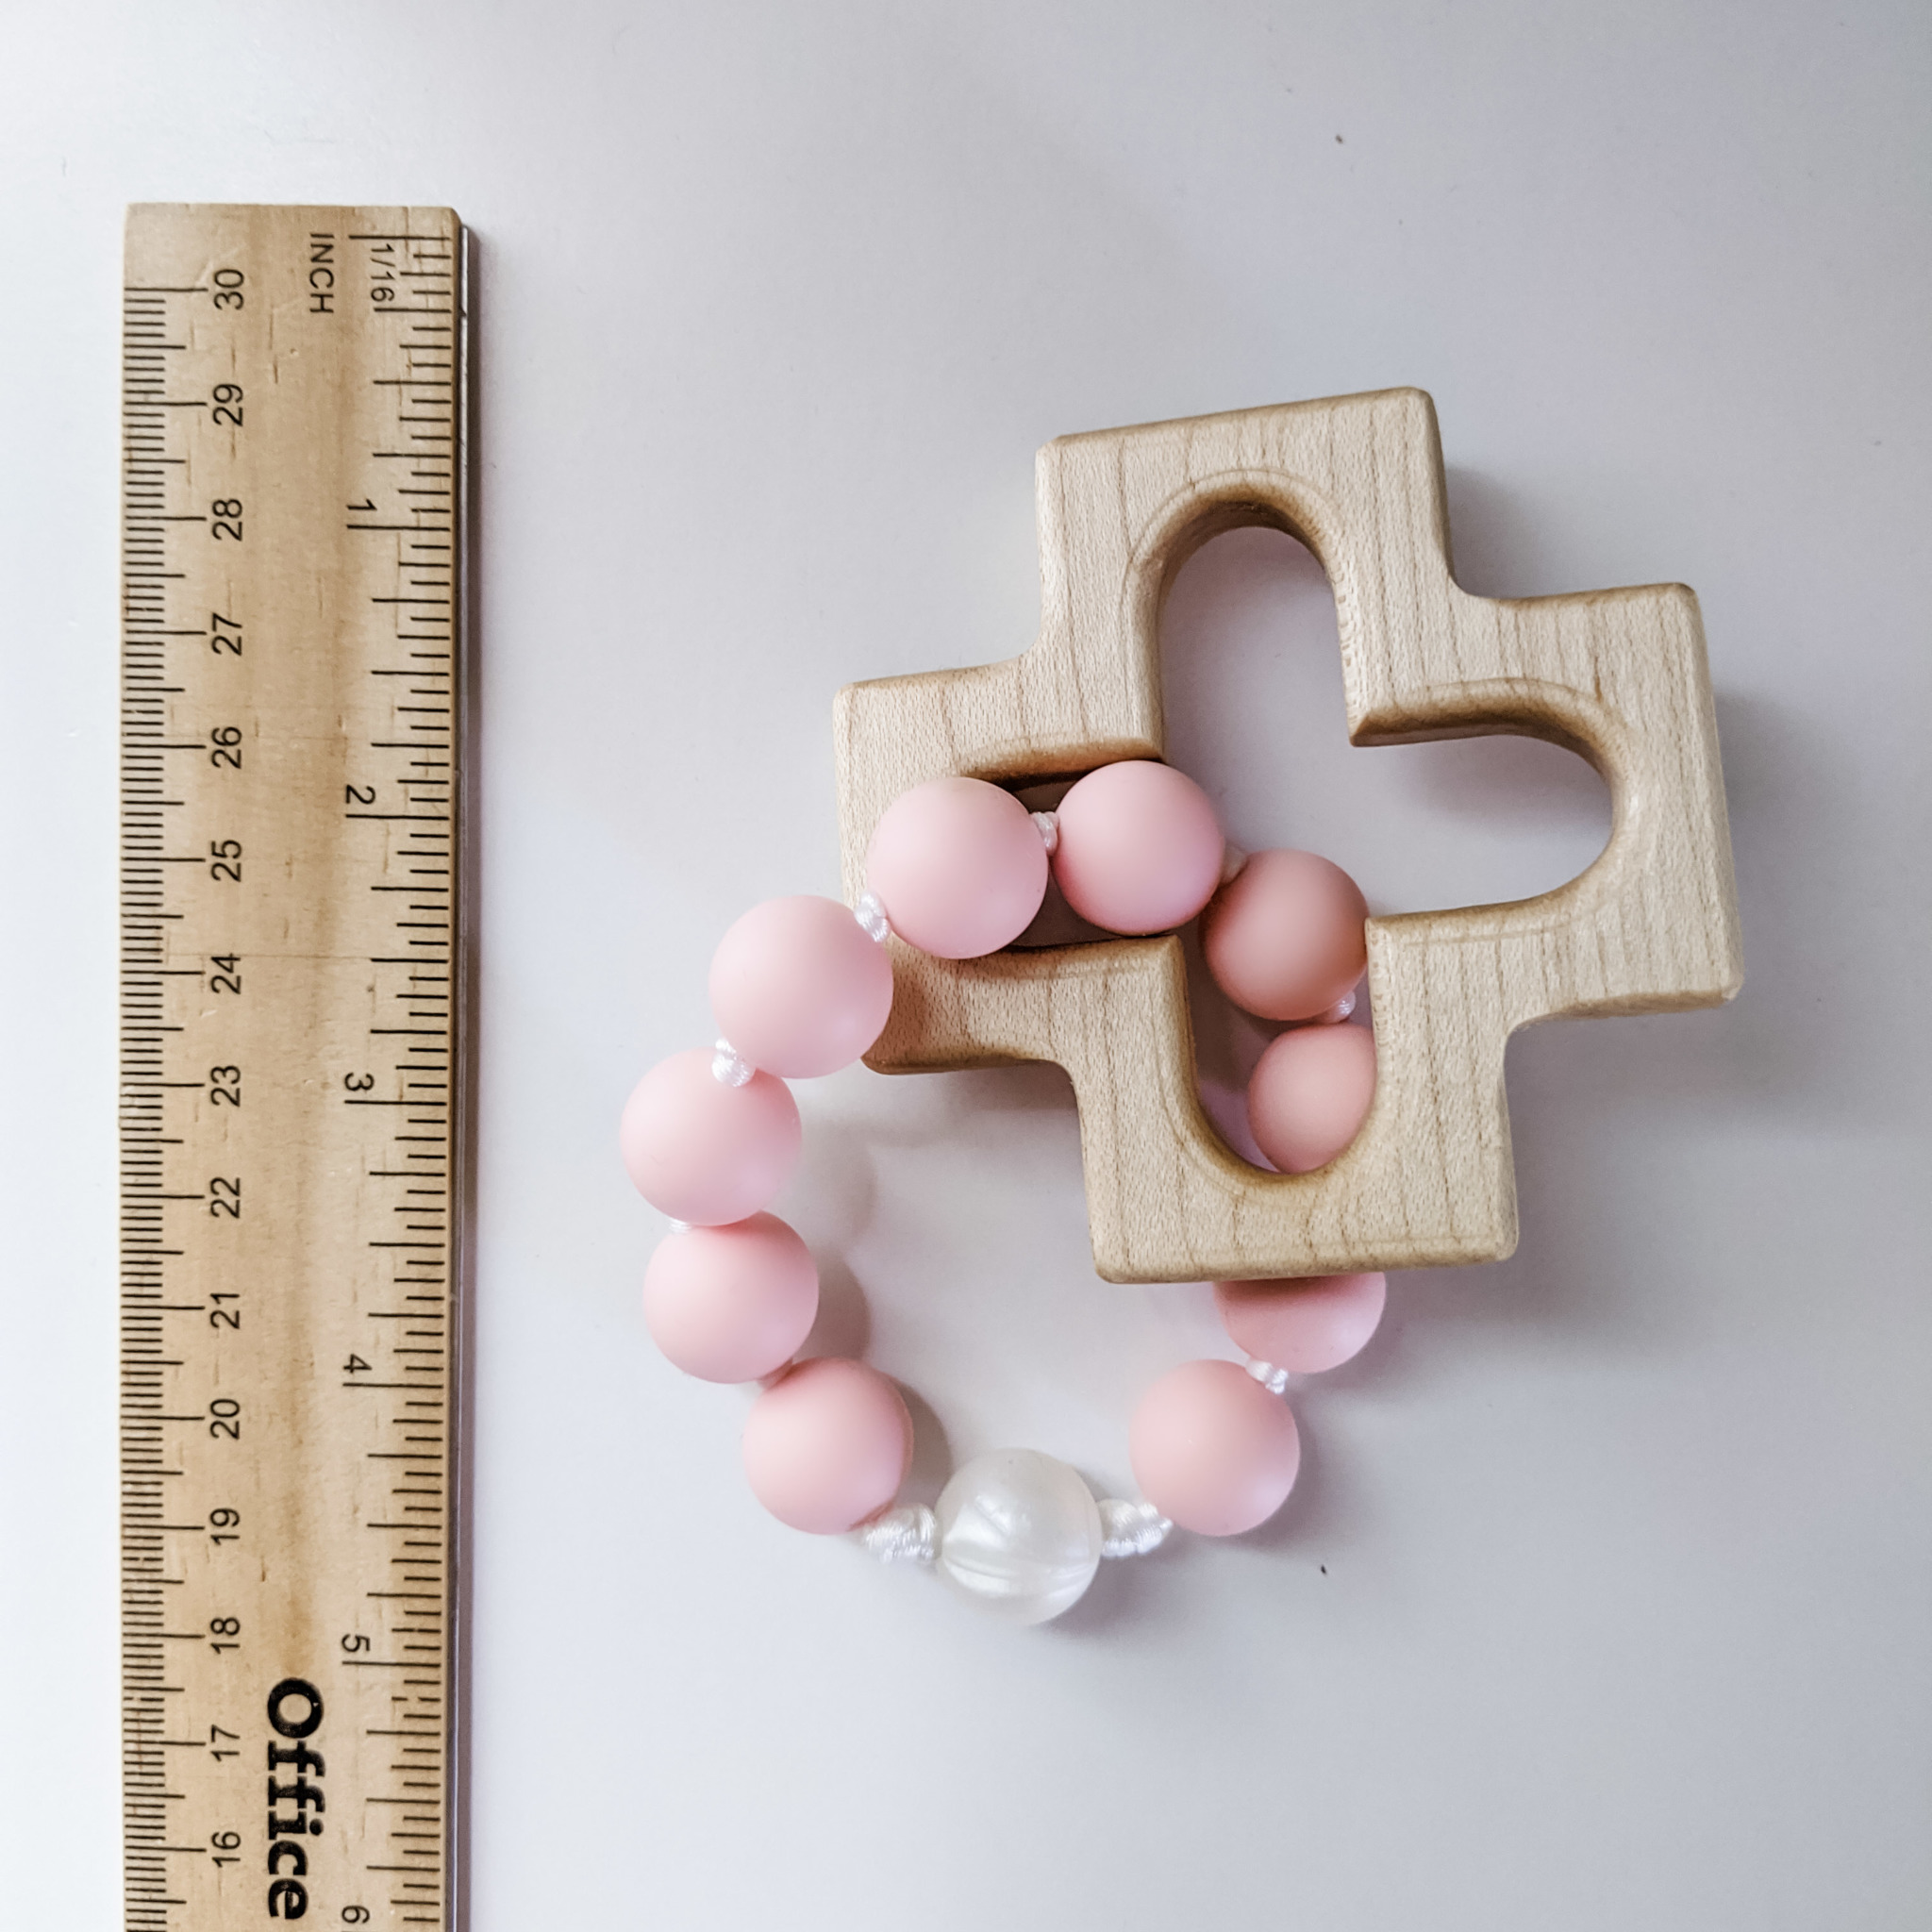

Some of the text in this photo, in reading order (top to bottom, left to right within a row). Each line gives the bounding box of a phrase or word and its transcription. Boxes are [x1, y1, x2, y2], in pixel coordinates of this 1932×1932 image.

[212, 268, 245, 311] 30
[308, 232, 335, 314] INCH
[370, 242, 396, 303] 1/16
[211, 383, 244, 427] 29
[210, 498, 243, 542] 28
[345, 498, 378, 512] 1
[209, 611, 243, 657] 27
[209, 725, 243, 770] 26
[344, 783, 376, 806] 2
[209, 839, 243, 883] 25
[208, 952, 242, 995] 24
[208, 1064, 242, 1108] 23
[342, 1072, 375, 1093] 3
[208, 1176, 242, 1220] 22
[208, 1292, 241, 1330] 21
[341, 1353, 373, 1375] 4
[208, 1398, 242, 1441] 20
[208, 1507, 241, 1546] 19
[208, 1616, 242, 1656] 18
[340, 1633, 371, 1654] 5
[209, 1724, 241, 1763] 17
[266, 1676, 326, 1922] Office
[209, 1830, 242, 1869] 16
[341, 1905, 371, 1924] 6
